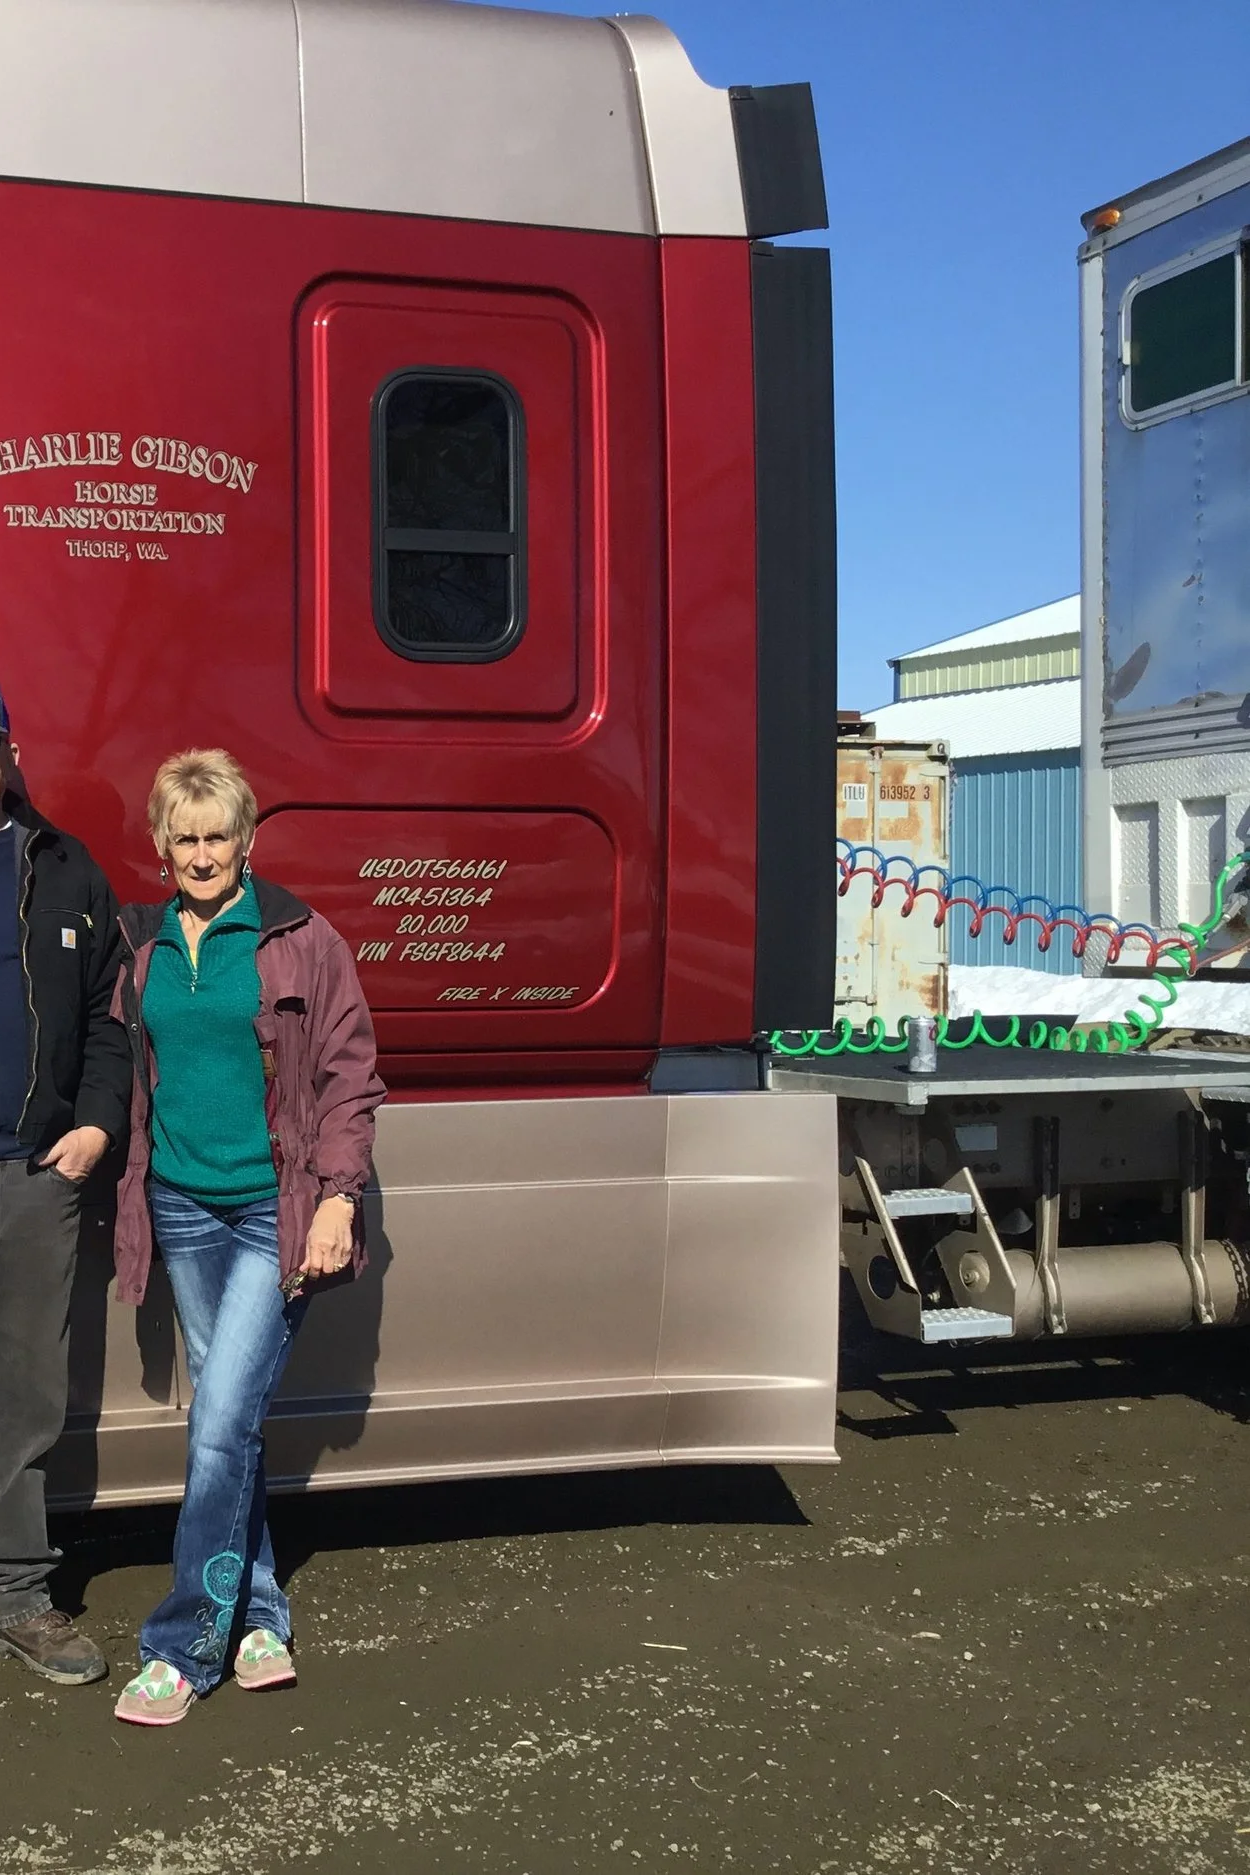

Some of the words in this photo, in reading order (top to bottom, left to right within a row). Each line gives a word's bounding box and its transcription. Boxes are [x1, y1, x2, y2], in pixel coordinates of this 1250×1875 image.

[131, 435, 258, 494] GIBSON
[74, 480, 158, 506] HORSE
[3, 504, 226, 535] TRANSPORTATION
[66, 539, 131, 561] THORP,
[923, 785, 931, 800] 3
[358, 858, 508, 880] USDOT566161
[372, 886, 494, 907] MC451364
[395, 914, 470, 937] 80,000
[356, 942, 394, 962] VIN
[398, 942, 506, 962] FSGF8644
[436, 986, 487, 1001] FIRE
[489, 987, 509, 1001] X
[511, 986, 580, 1001] INSIDE
